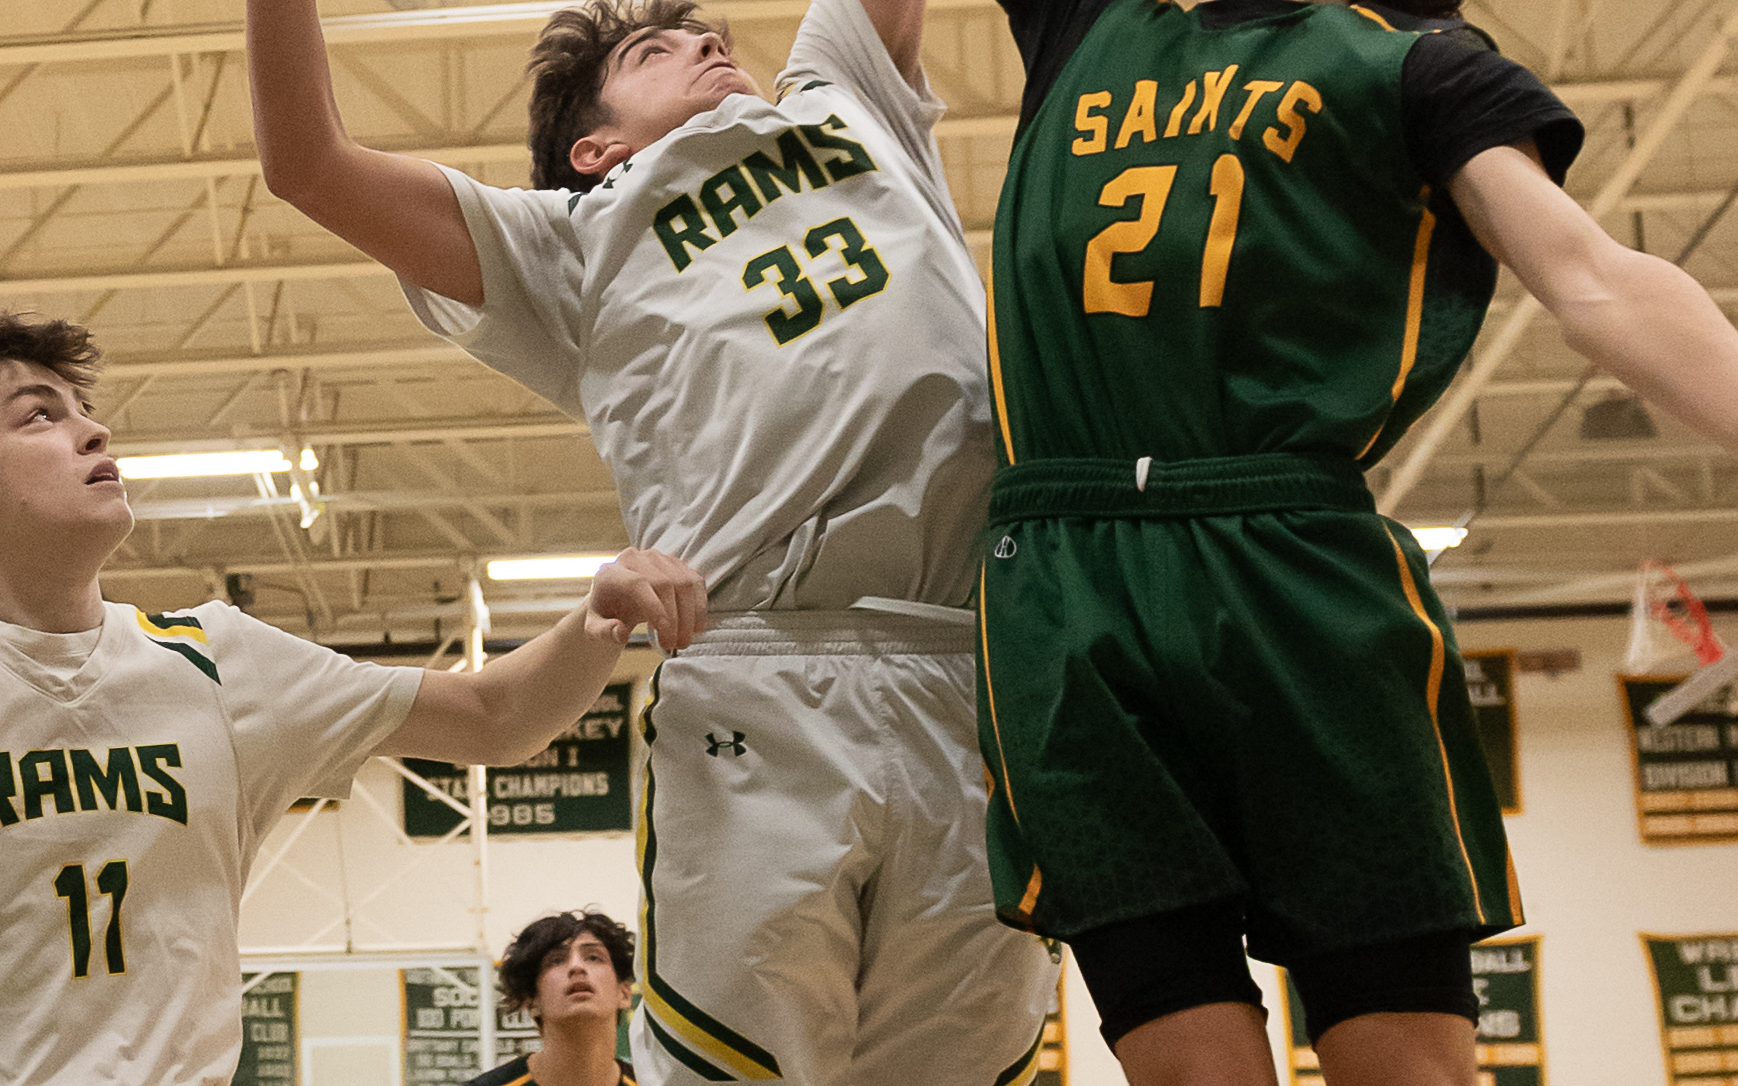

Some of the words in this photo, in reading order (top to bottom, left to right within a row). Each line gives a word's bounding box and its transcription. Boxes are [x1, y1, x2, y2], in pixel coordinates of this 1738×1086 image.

[1072, 64, 1323, 164] SAINTS
[652, 113, 881, 274] RAMS
[1082, 153, 1245, 318] 21
[739, 215, 892, 348] 33
[493, 771, 610, 799] CHAMPIONS
[556, 718, 624, 741] KEY
[487, 802, 556, 826] 985
[51, 857, 130, 980] 11
